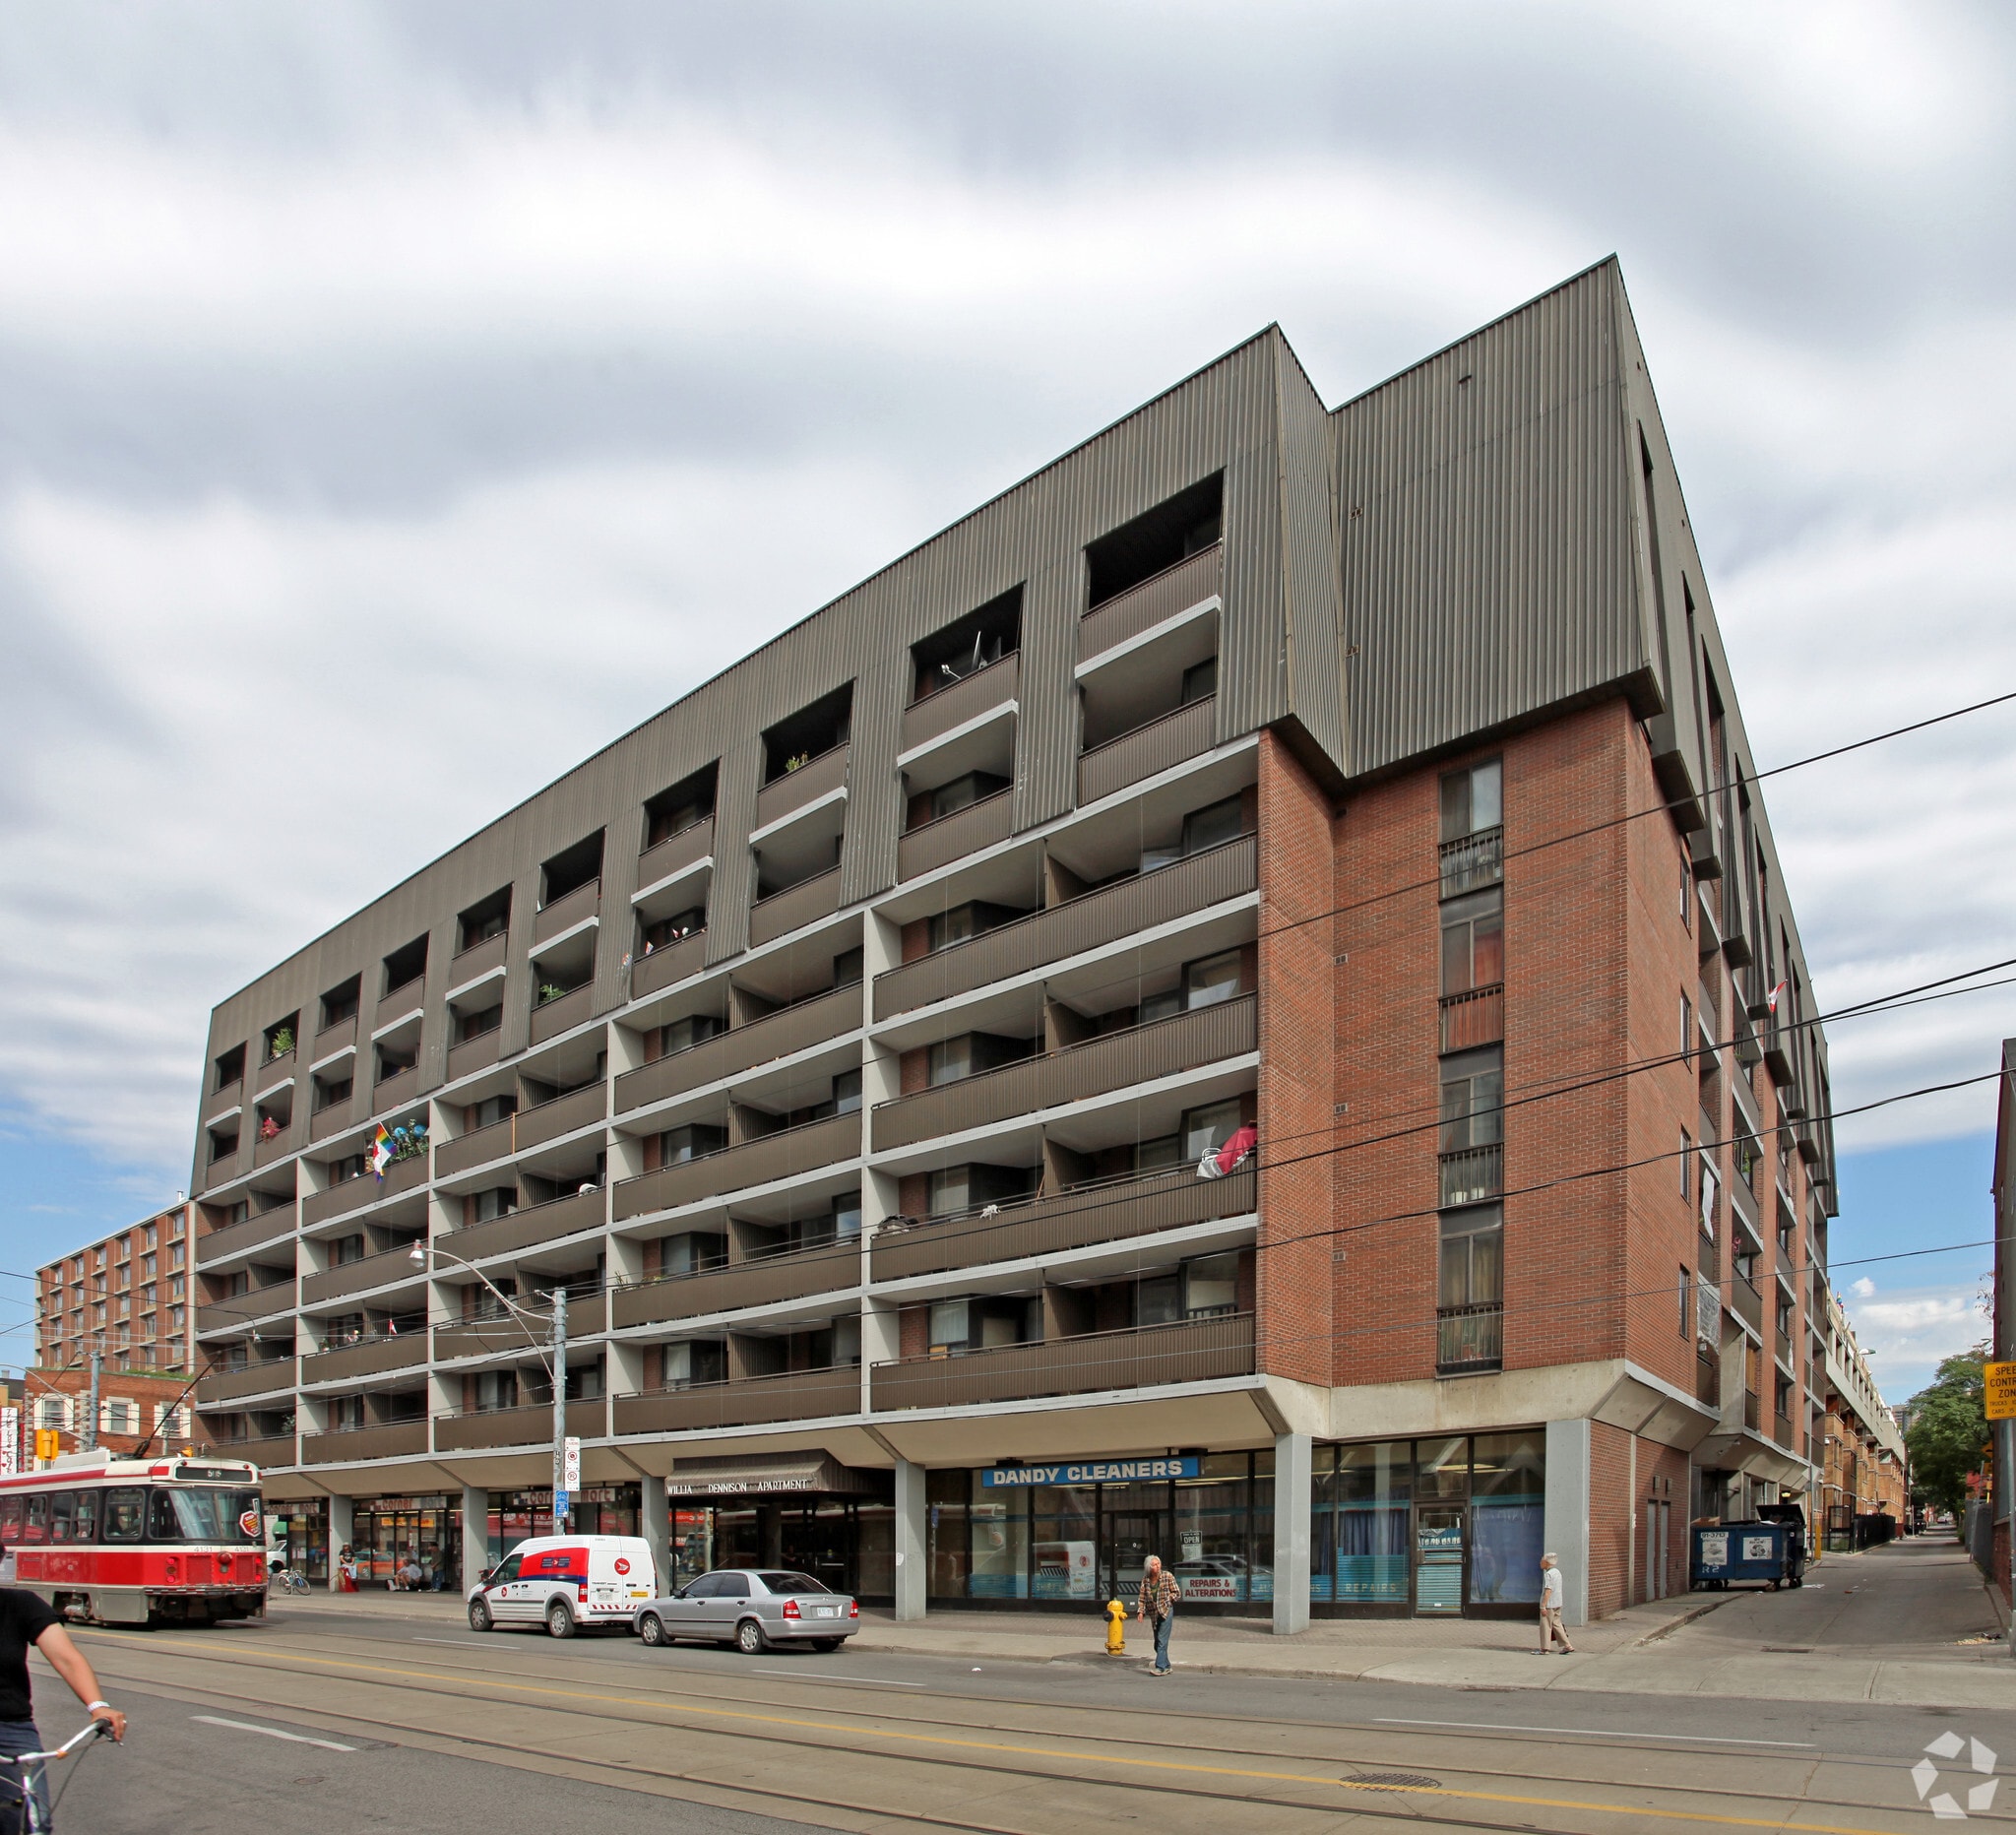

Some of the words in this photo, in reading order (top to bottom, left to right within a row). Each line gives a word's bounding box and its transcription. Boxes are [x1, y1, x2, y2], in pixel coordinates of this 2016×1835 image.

[1995, 1365, 2016, 1375] SPEE
[1989, 1377, 2016, 1387] CONTR
[1998, 1388, 2016, 1398] ZON
[993, 1468, 1060, 1485] DANDY
[1067, 1460, 1182, 1482] CLEANERS
[708, 1482, 747, 1493] DENNISON
[757, 1479, 807, 1491] APARTMENT
[382, 1498, 412, 1510] corner
[1190, 1579, 1221, 1588] REPAIRS
[1225, 1579, 1229, 1588] &
[1346, 1583, 1397, 1593] REPAIRS
[1185, 1589, 1236, 1598] ALTERATIONS
